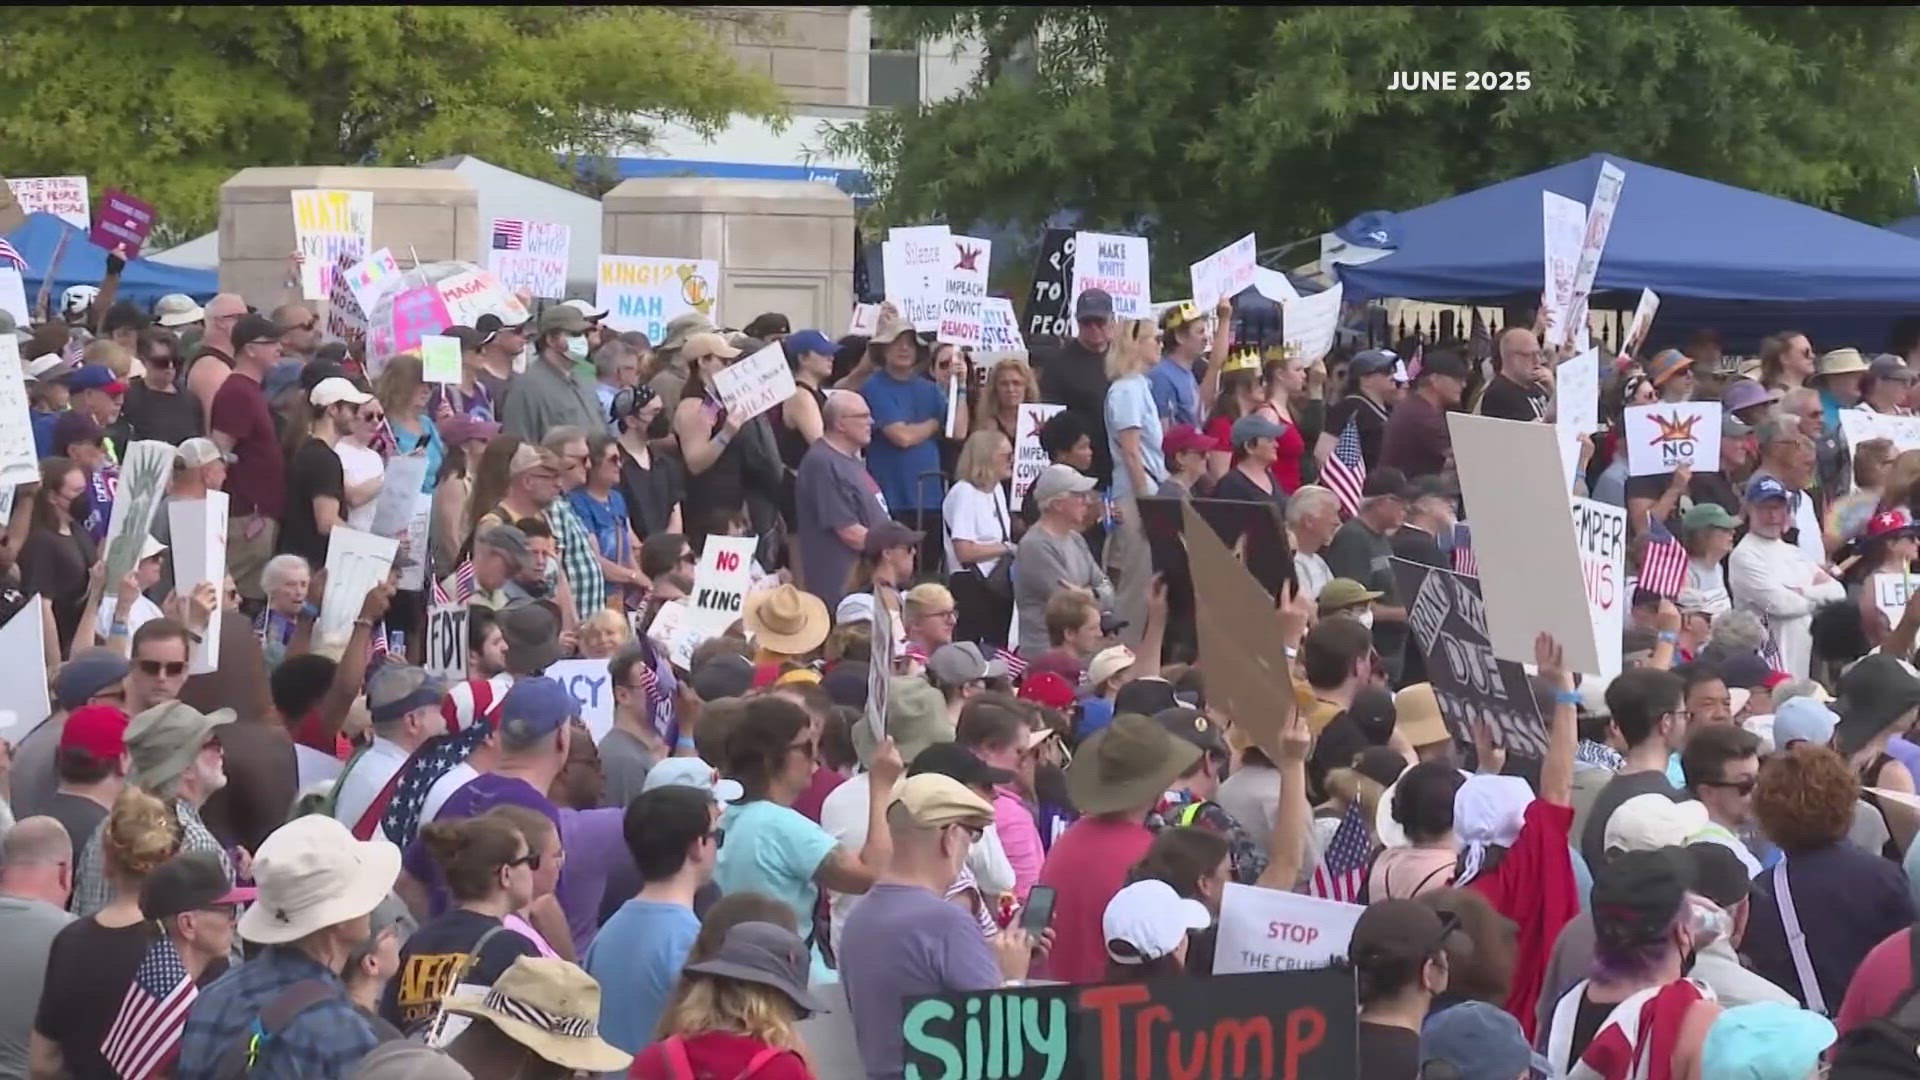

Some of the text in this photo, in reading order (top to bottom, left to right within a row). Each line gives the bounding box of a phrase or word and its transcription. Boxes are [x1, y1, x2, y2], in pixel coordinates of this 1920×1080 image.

[945, 278, 984, 297] IMPEACH
[1035, 281, 1062, 301] TO
[943, 299, 982, 318] CONVICT
[941, 320, 980, 340] REMOVE
[1019, 447, 1048, 461] IMPEA
[1663, 441, 1694, 458] NO
[716, 550, 739, 572] NO
[697, 588, 742, 612] KING
[431, 609, 467, 670] FDT
[1267, 920, 1320, 946] STOP
[1240, 950, 1271, 969] THE
[903, 983, 1328, 1080] Silly Trump
